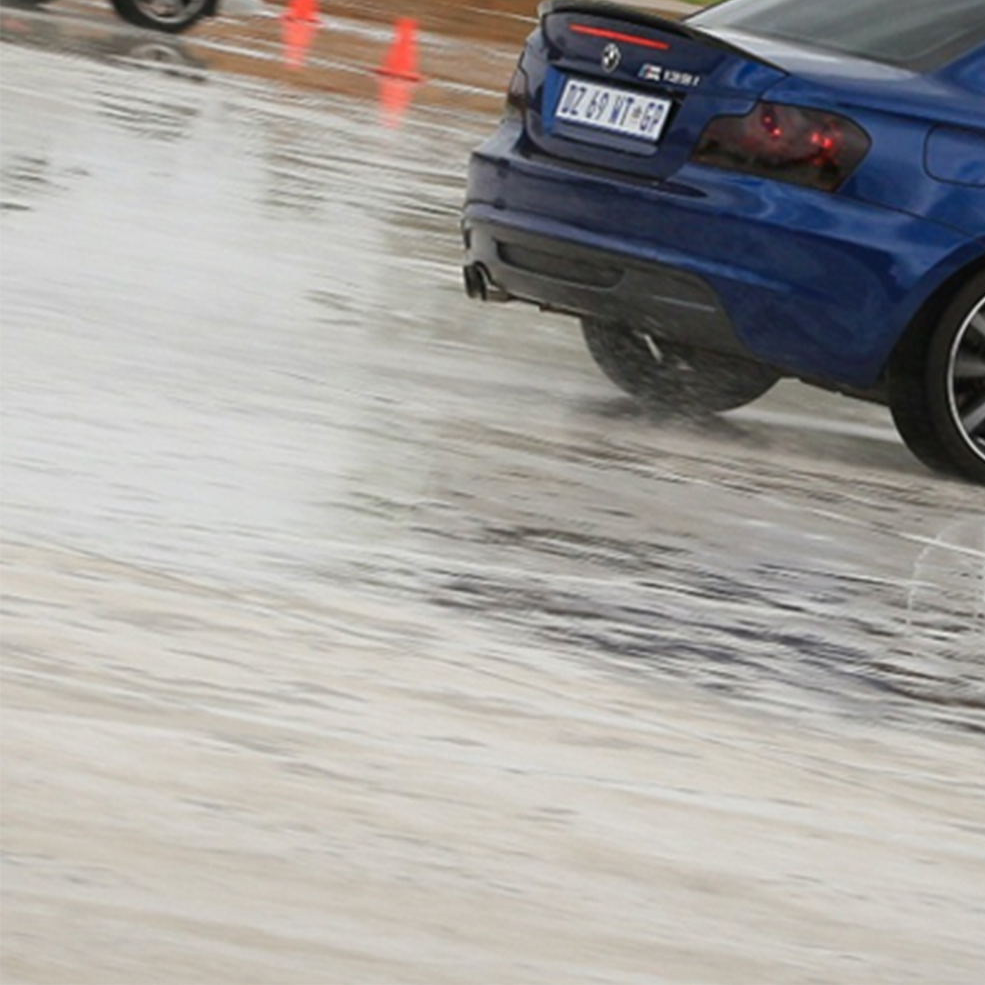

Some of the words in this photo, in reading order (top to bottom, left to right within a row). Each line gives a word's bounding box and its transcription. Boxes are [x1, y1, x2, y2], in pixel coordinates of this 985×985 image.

[562, 84, 586, 116] DZ
[586, 90, 609, 121] 69
[639, 102, 664, 133] GP
